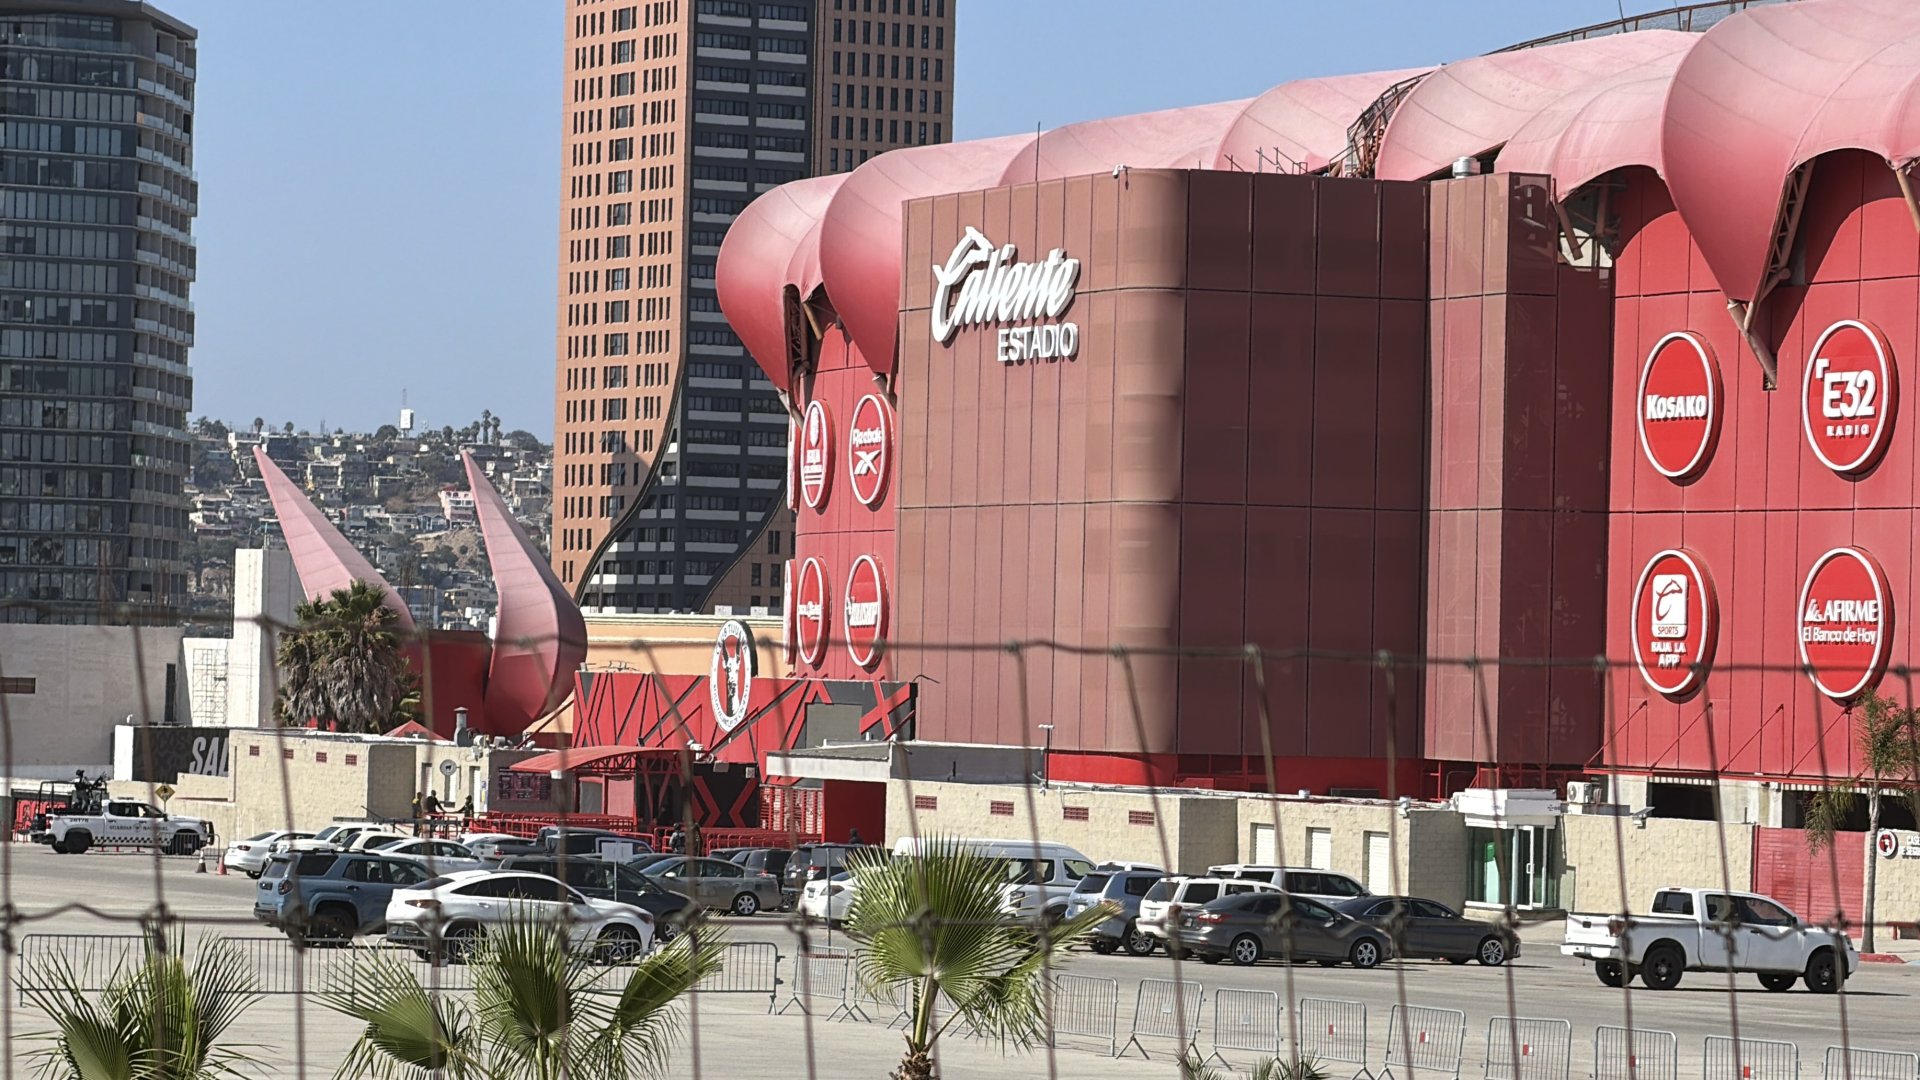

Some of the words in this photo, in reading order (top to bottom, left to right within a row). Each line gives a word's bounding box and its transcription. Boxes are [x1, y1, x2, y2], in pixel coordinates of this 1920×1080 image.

[931, 226, 1080, 343] Caliente
[997, 322, 1078, 362] ESTADIO
[852, 427, 883, 448] Reebok
[1826, 424, 1870, 437] RADIO
[1823, 599, 1879, 623] AFIRME
[1657, 626, 1679, 635] SPORTS
[1802, 626, 1811, 642] El
[1812, 626, 1843, 642] Banco
[1843, 626, 1857, 642] de
[1857, 626, 1878, 645] Hoy
[1651, 641, 1673, 653] BAJA
[1673, 641, 1687, 653] LA
[1658, 653, 1681, 668] APP
